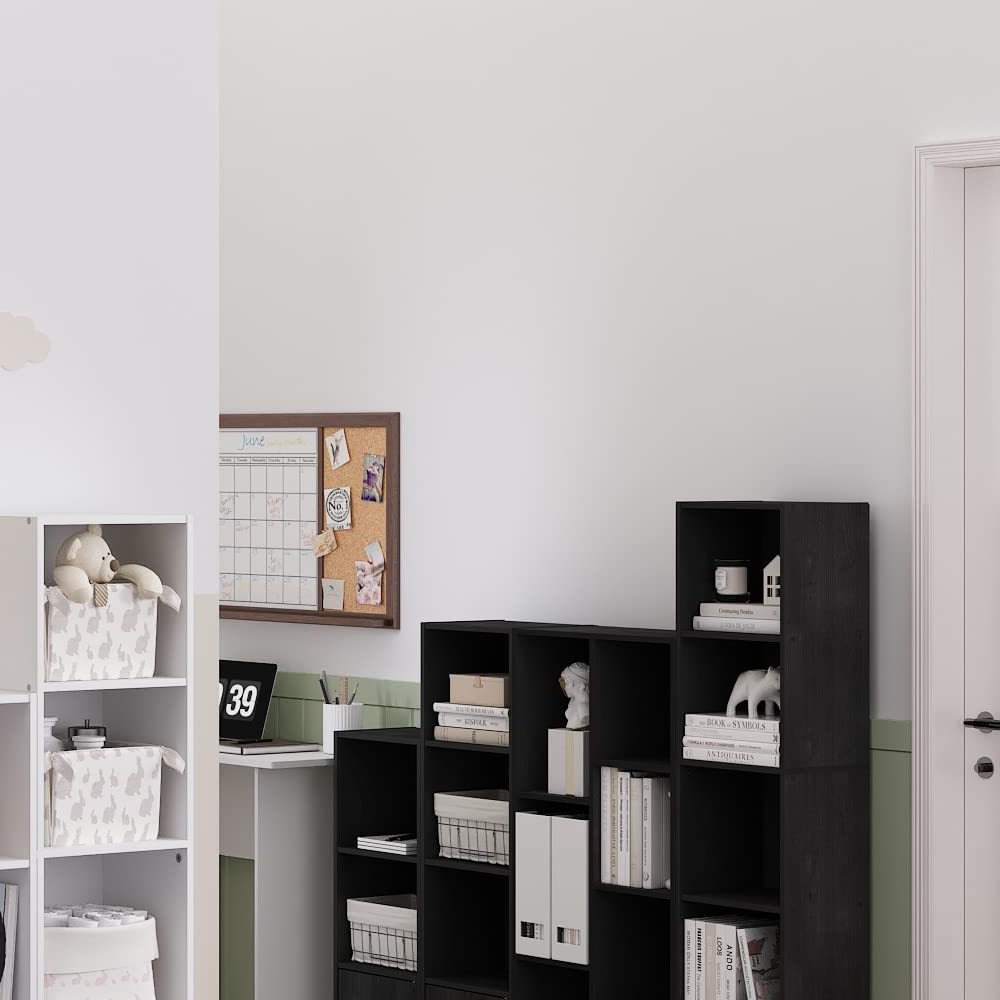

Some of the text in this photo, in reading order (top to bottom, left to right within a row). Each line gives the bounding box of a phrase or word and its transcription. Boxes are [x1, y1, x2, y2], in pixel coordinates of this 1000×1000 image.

[237, 434, 265, 450] June
[328, 498, 344, 511] No.
[225, 683, 258, 717] 39
[707, 719, 725, 728] BOOK
[732, 720, 766, 730] SYMBOLS
